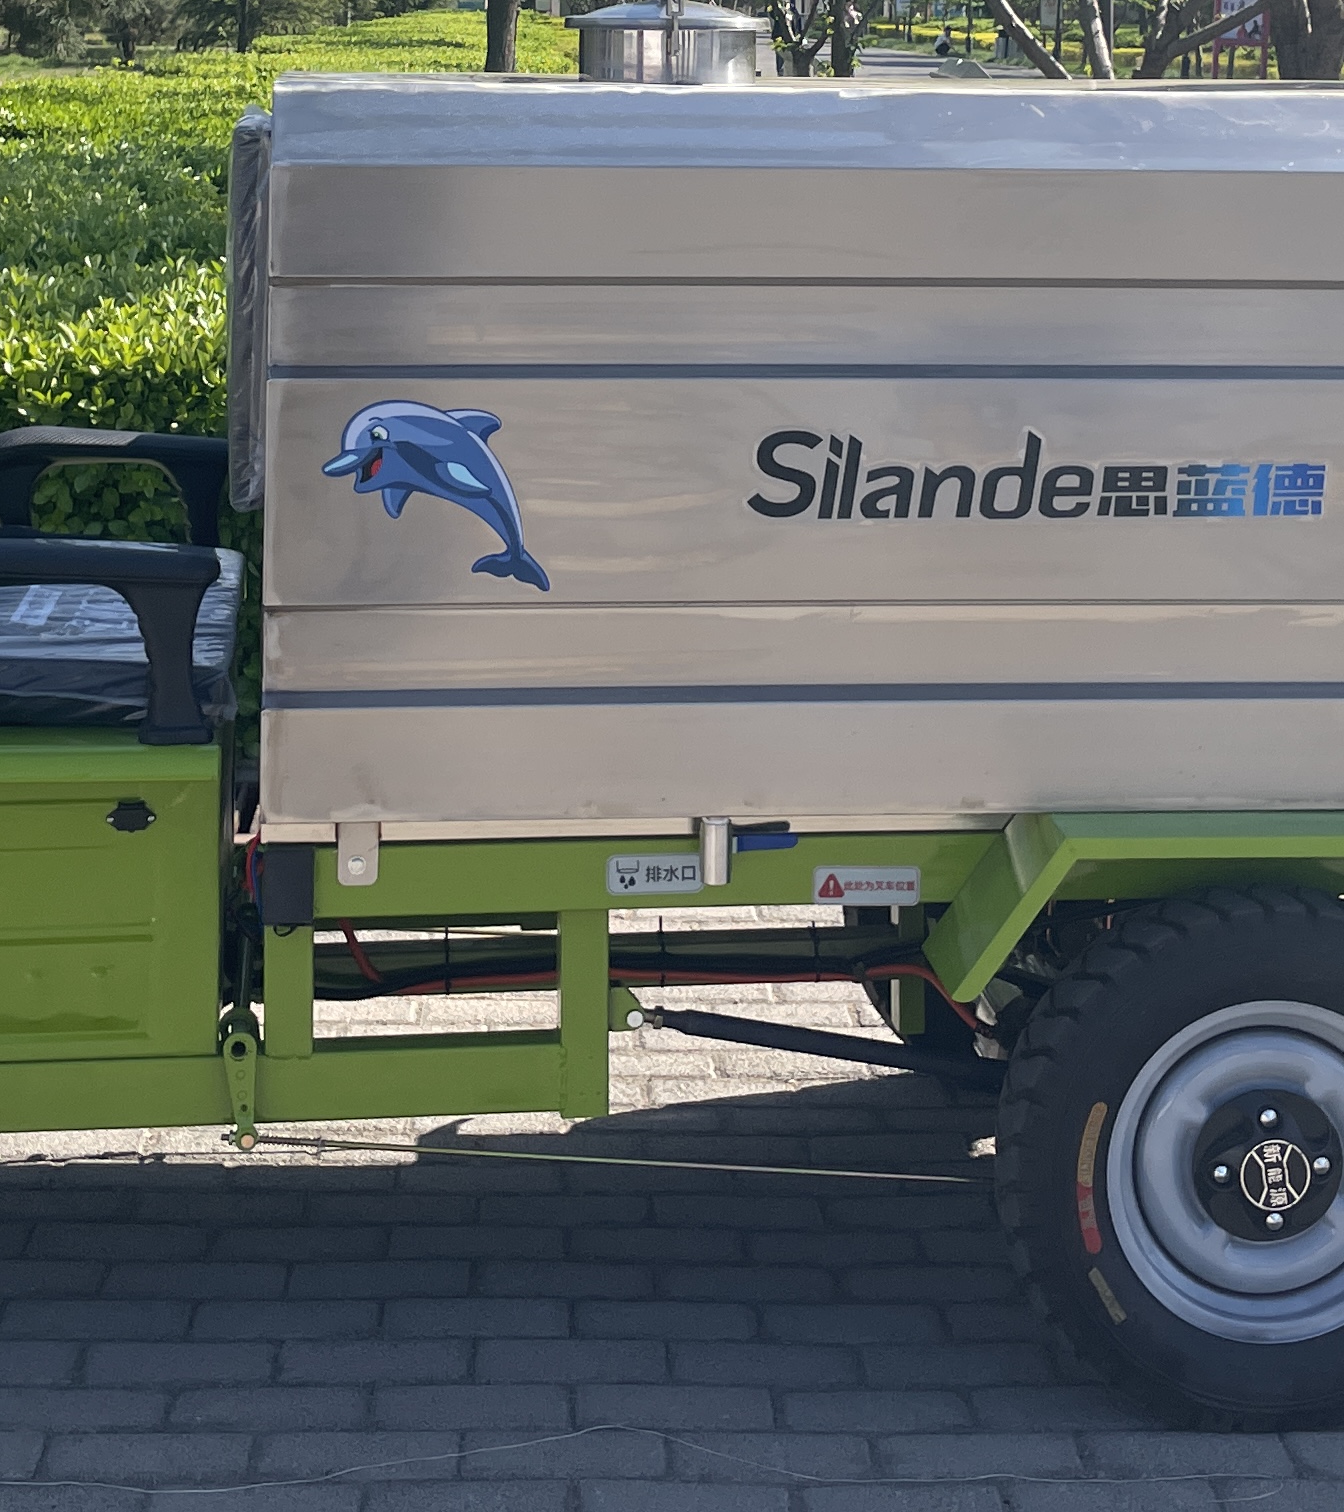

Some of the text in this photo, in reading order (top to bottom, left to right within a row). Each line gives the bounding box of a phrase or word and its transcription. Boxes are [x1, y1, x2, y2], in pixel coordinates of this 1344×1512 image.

[746, 430, 1327, 520] Silande 思蓝德
[645, 865, 696, 883] 排水口
[1262, 1143, 1289, 1207] 新能源
